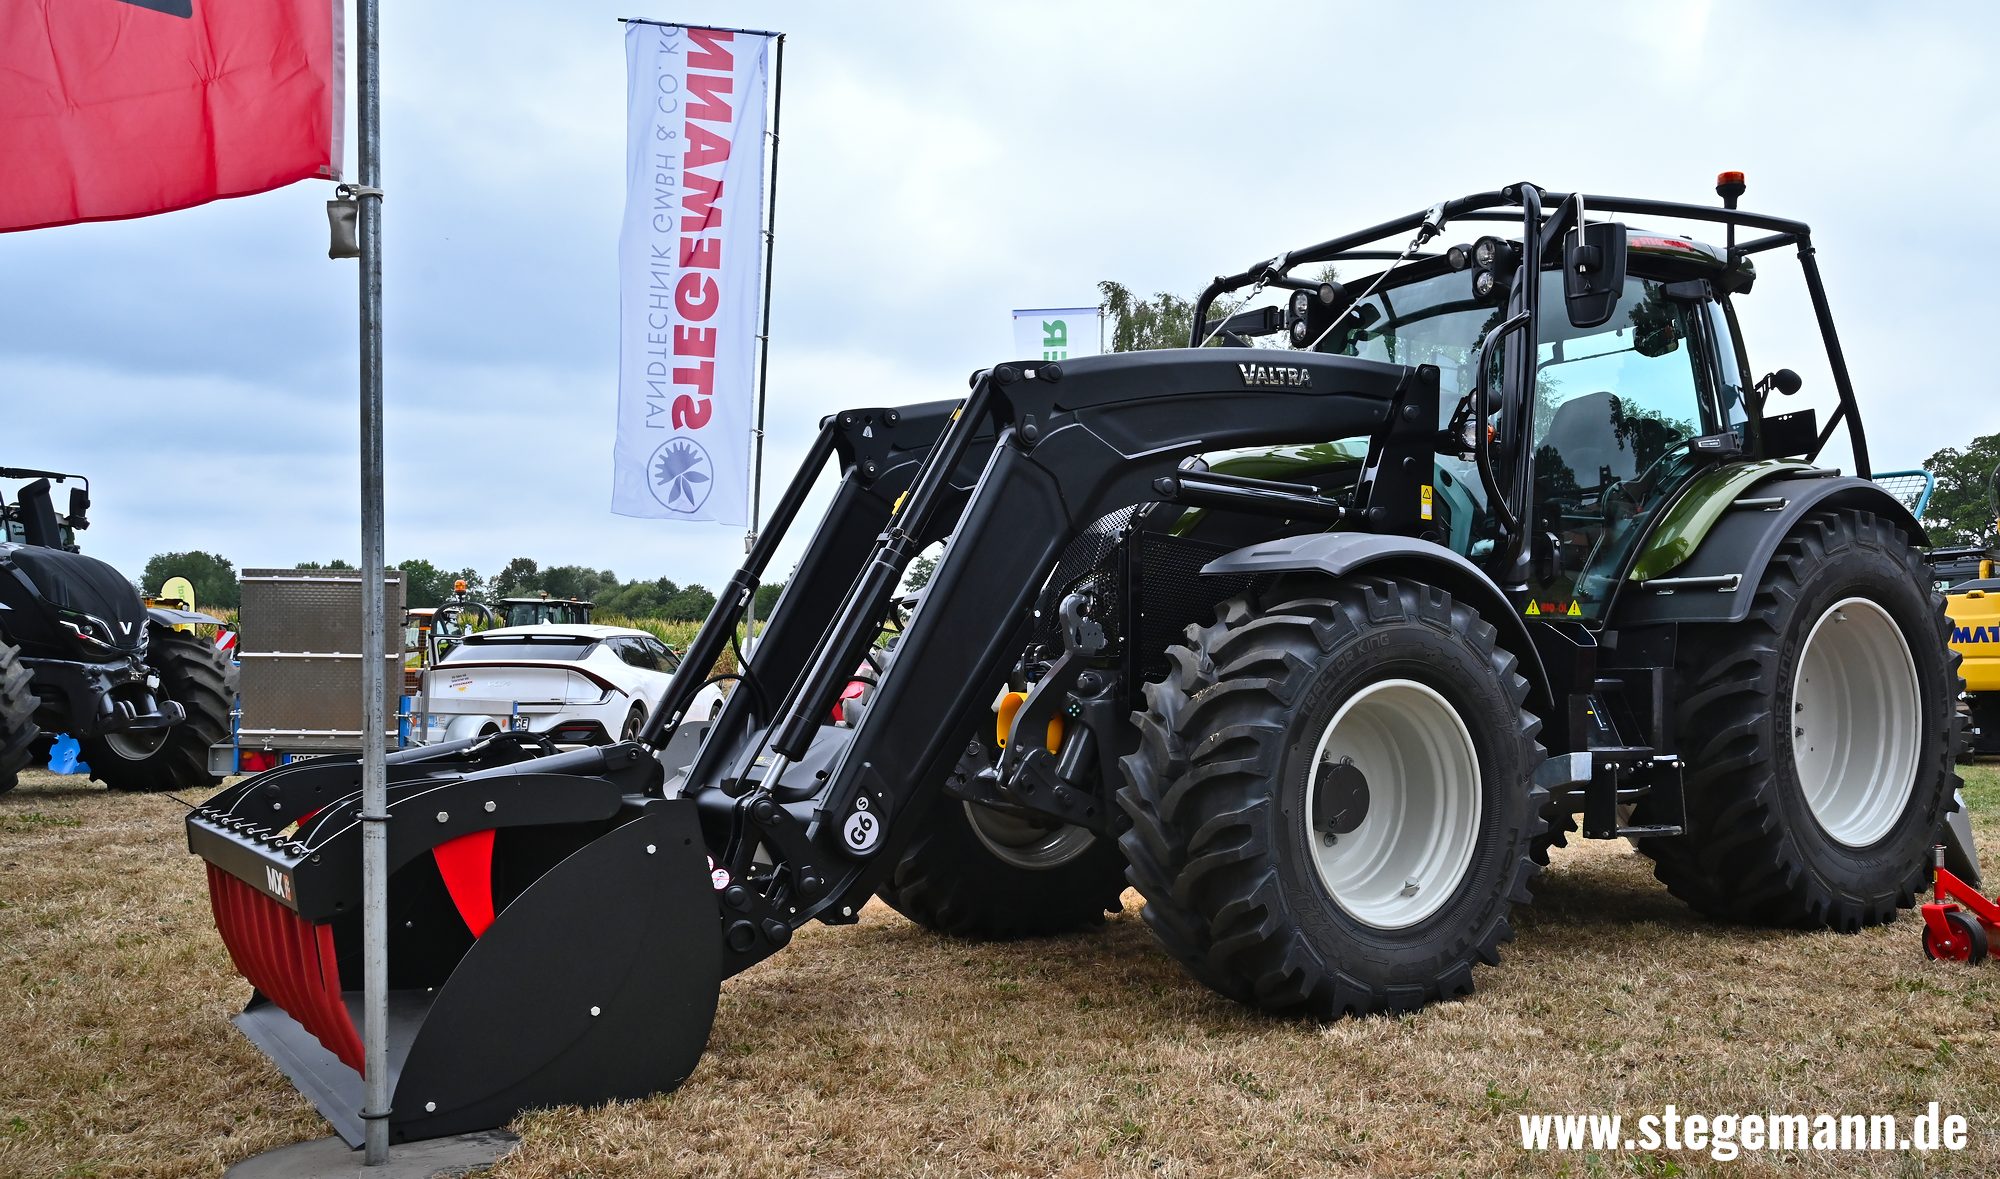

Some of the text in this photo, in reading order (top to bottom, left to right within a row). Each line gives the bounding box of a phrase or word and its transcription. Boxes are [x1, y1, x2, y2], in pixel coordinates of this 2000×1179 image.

[1239, 363, 1312, 387] VALTRA
[119, 621, 132, 635] V
[1303, 633, 1390, 716] TRACTOR KING
[851, 799, 872, 845] G6 S
[266, 865, 285, 898] MX
